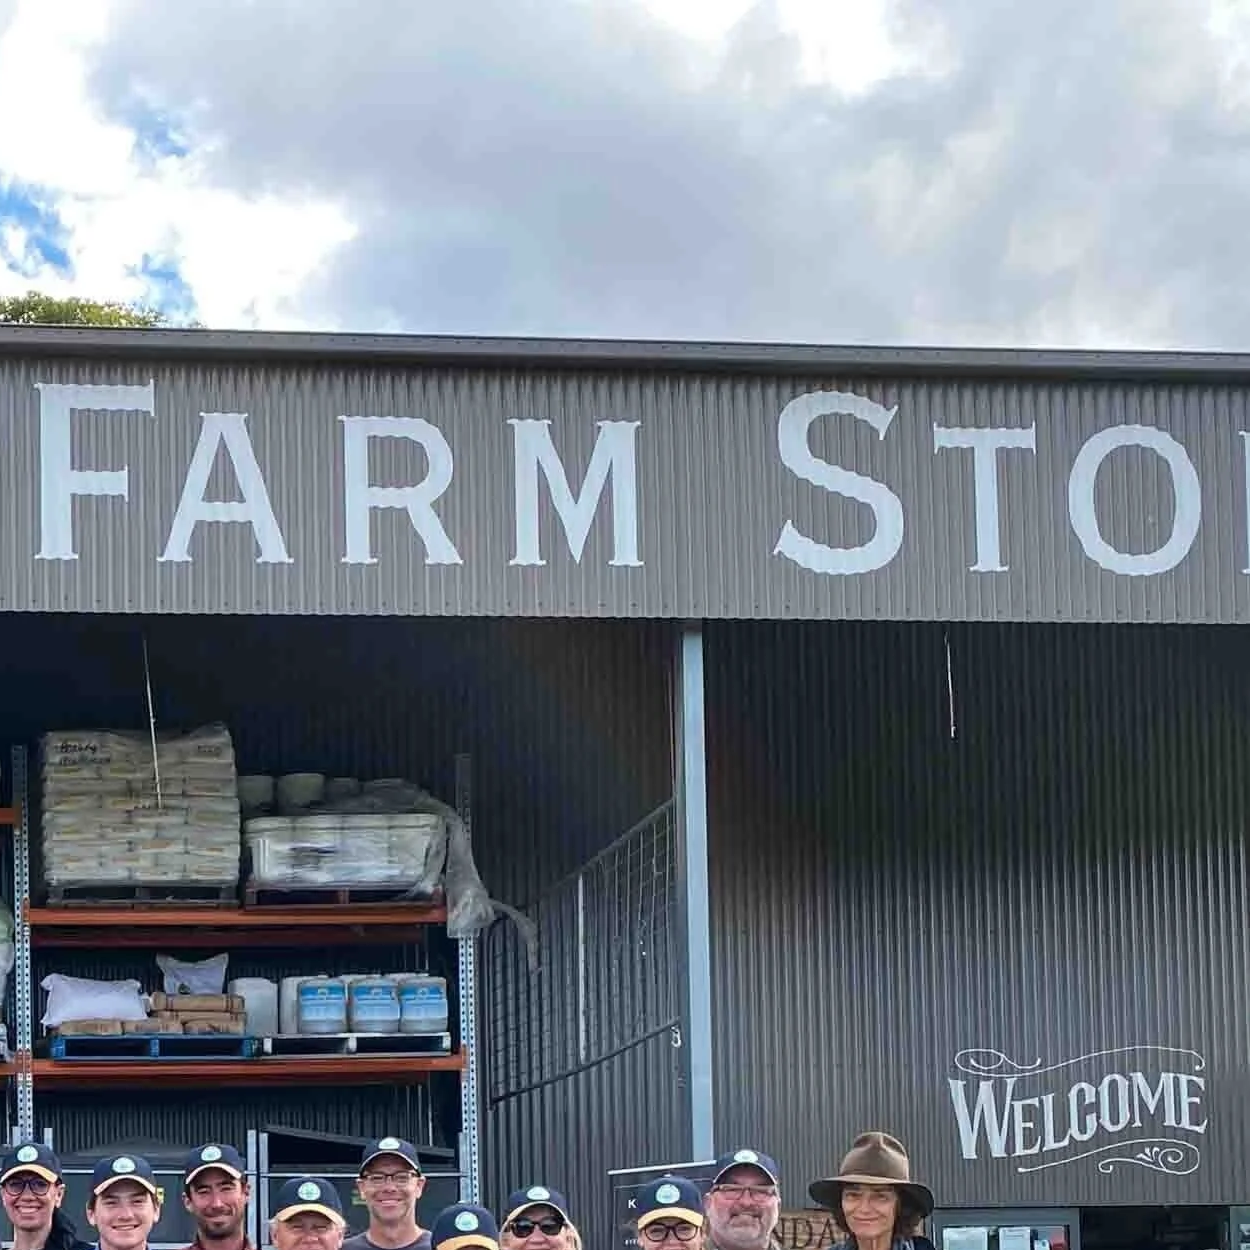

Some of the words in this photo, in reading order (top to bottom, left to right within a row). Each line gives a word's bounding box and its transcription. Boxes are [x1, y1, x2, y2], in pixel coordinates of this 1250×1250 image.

[34, 379, 645, 568] FARM
[773, 389, 1250, 577] STO
[948, 1071, 1208, 1160] WELCOME
